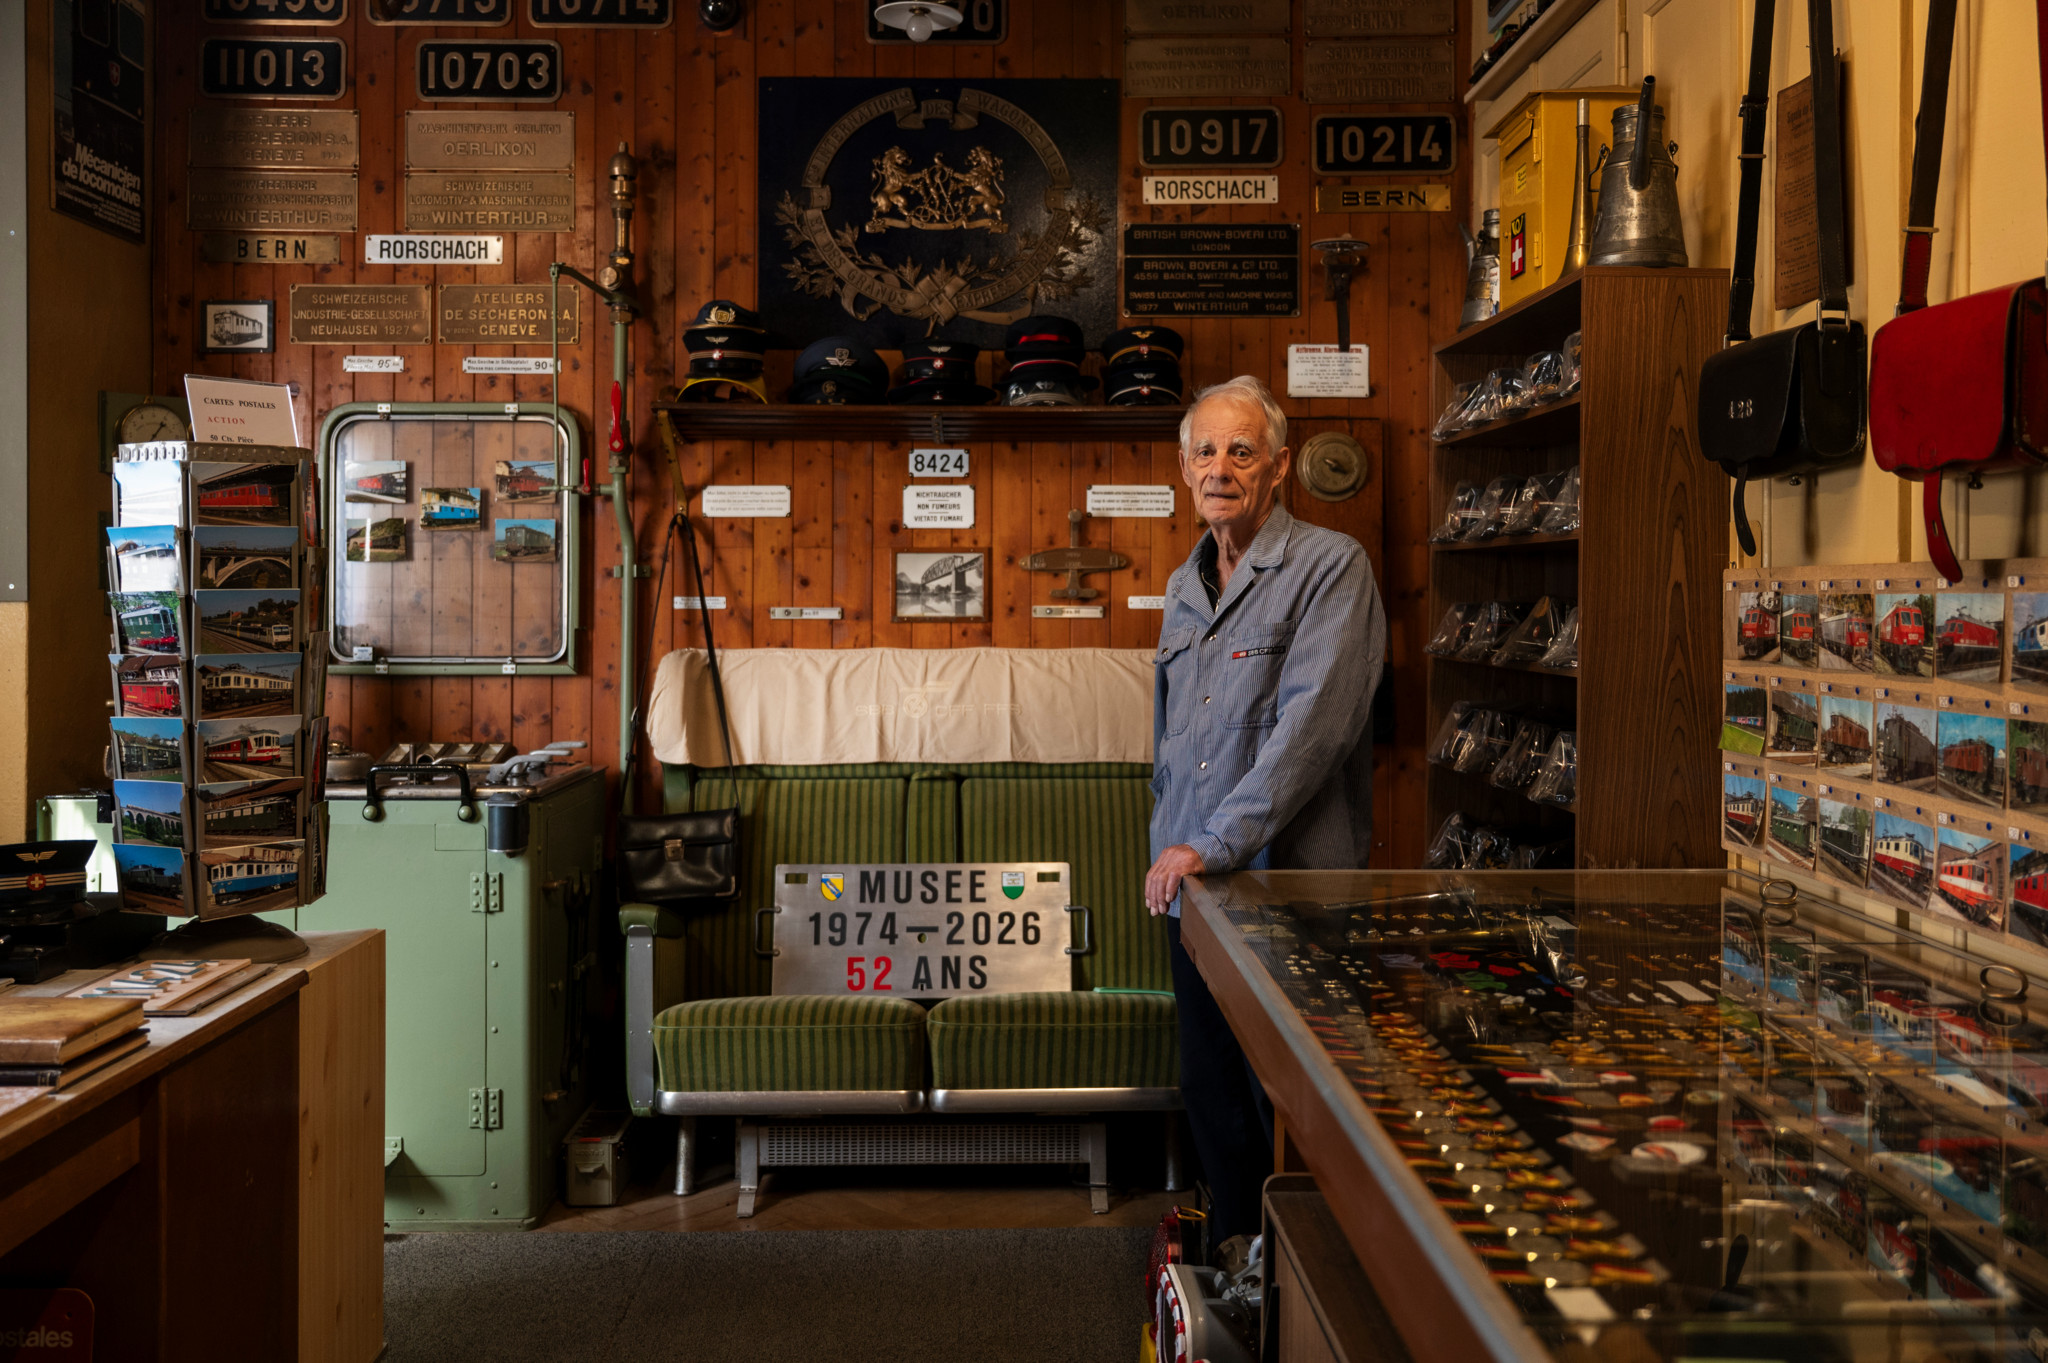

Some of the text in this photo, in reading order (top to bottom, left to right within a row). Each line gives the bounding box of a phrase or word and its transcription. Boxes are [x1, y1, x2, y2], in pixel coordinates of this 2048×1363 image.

[219, 48, 325, 87] 11013
[427, 51, 551, 90] 10703
[926, 101, 951, 115] DES
[1152, 118, 1268, 157] 10917
[1325, 124, 1443, 164] 10214
[444, 142, 536, 156] OERLIKON
[75, 141, 141, 191] Mécanicien
[62, 156, 79, 181] de
[79, 160, 141, 208] locomotive
[445, 181, 533, 191] SCHWEIZERISCHE
[1154, 180, 1266, 200] RORSCHACH
[1341, 190, 1427, 207] BERN
[214, 210, 332, 224] WINTERTHUR
[431, 211, 548, 225] WINTERTHUR
[1133, 229, 1176, 239] BRITISH
[237, 238, 307, 259] BERN
[377, 239, 489, 260] RORSCHACH
[1191, 243, 1231, 251] LONDON
[1188, 261, 1229, 270] BOVERI
[311, 294, 409, 305] SCHWEIZERISCHE
[473, 293, 545, 305] ATELIERS
[1129, 291, 1155, 300] SWISS
[1173, 301, 1248, 311] WINTERTHUR
[445, 309, 463, 321] DE
[468, 308, 547, 321] SECHERON
[311, 325, 410, 336] NEUHAUSEN 1927
[534, 361, 548, 370] 90
[203, 397, 276, 410] CARTES POSTALES
[207, 416, 246, 425] ACTION
[210, 434, 219, 442] 50
[238, 436, 255, 444] Pièce
[914, 454, 965, 473] 8424
[855, 704, 897, 717] SBB
[860, 870, 986, 904] MUSEE
[847, 955, 987, 991] 52 ANS
